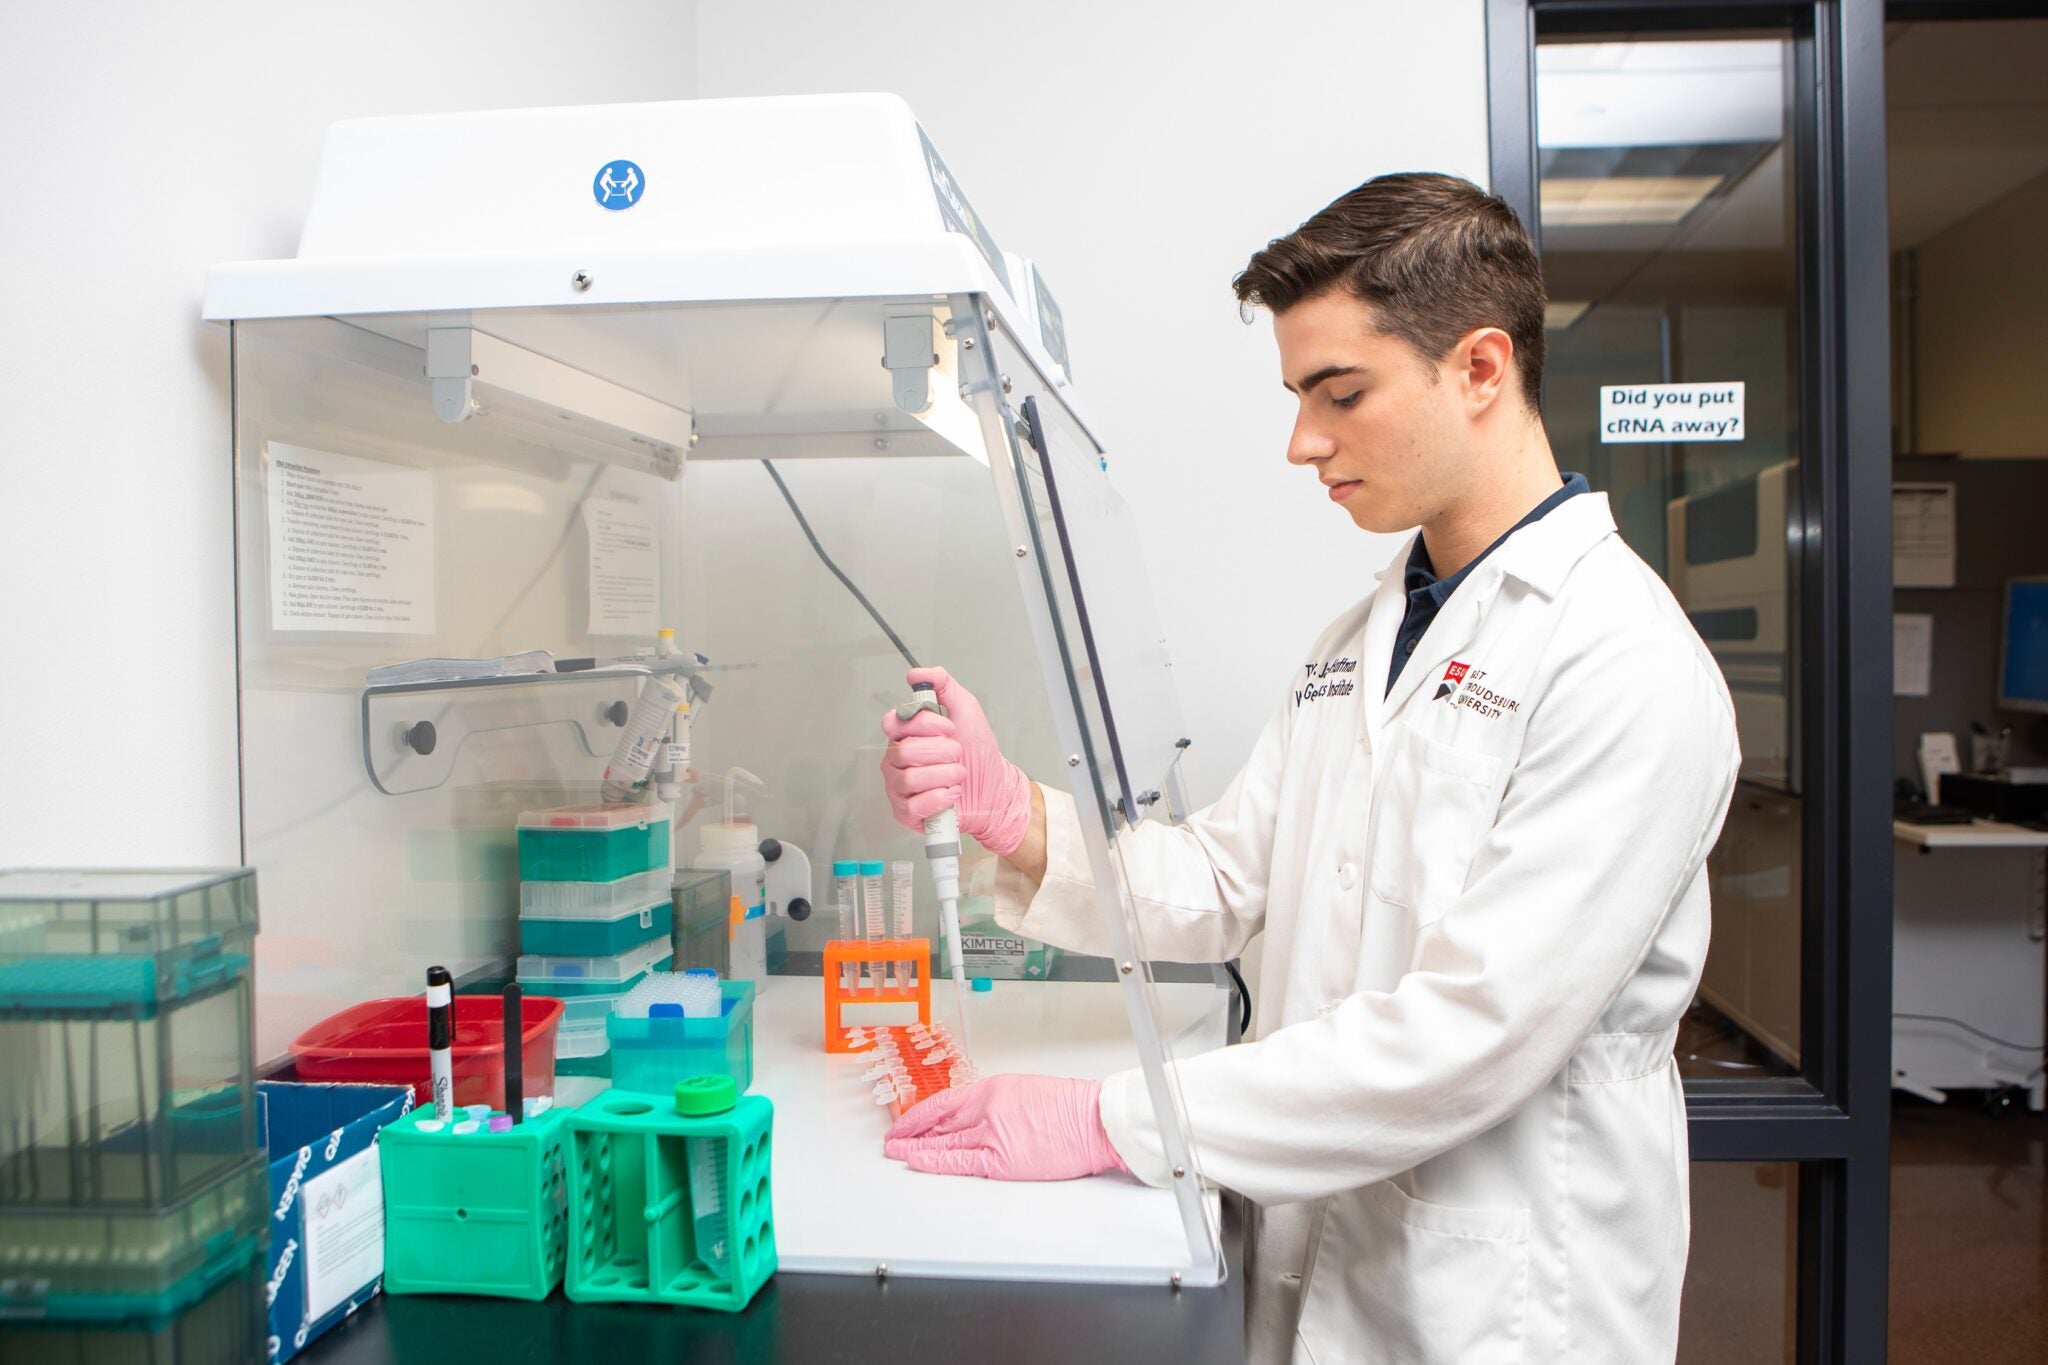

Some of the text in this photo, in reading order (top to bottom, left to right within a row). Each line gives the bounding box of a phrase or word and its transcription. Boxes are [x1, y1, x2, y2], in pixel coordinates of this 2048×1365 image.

[1612, 390, 1735, 409] Did you put
[1607, 417, 1740, 438] cRNA away?
[1449, 665, 1467, 678] ESU
[961, 938, 1024, 950] KIMTECH
[274, 1145, 312, 1222] QIAGEN
